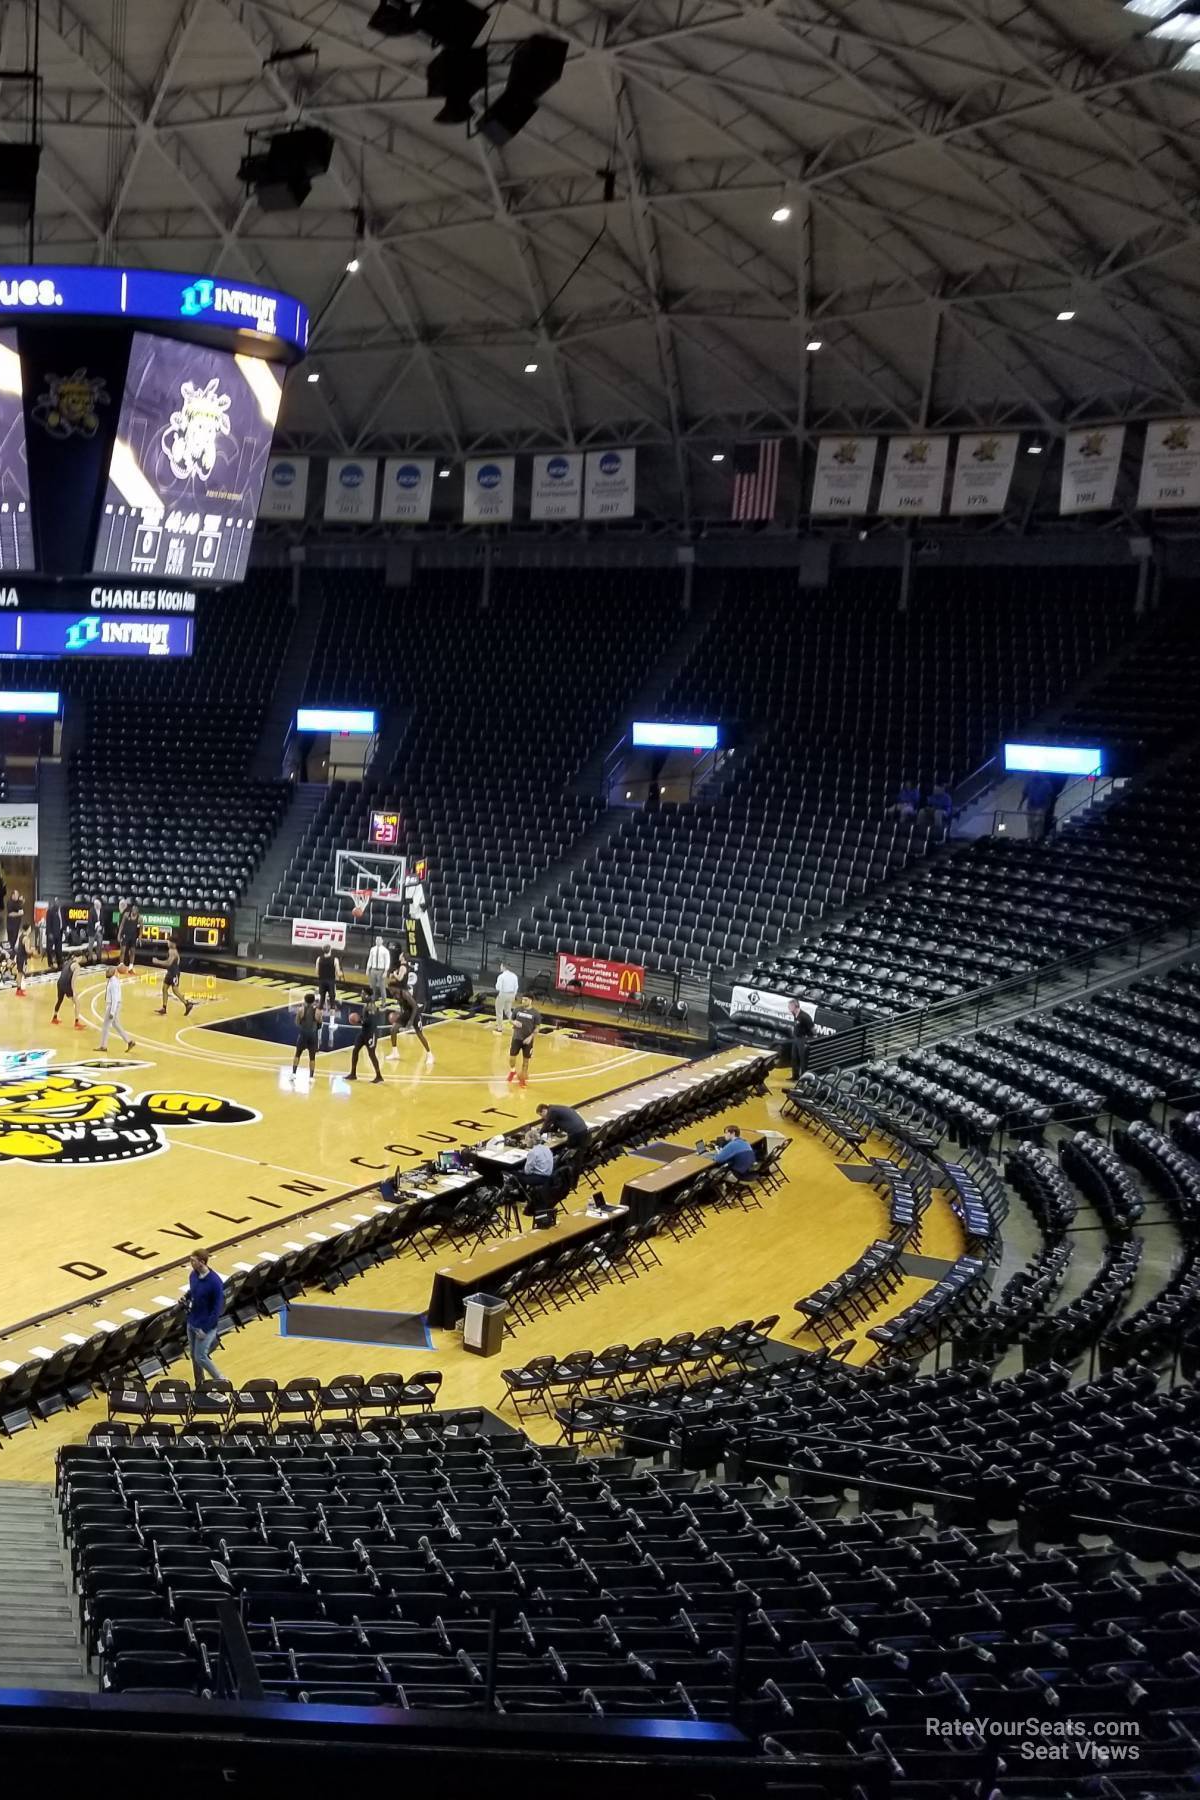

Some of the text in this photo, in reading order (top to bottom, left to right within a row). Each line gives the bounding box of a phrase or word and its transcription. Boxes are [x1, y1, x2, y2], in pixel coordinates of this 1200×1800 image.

[214, 287, 277, 321] INTRUST
[91, 588, 156, 610] CHARLES
[376, 824, 394, 841] 23
[294, 924, 344, 942] ESPN
[405, 919, 418, 957] WSU
[47, 1127, 151, 1142] WSU
[59, 1106, 519, 1281] DEVLIN COURT
